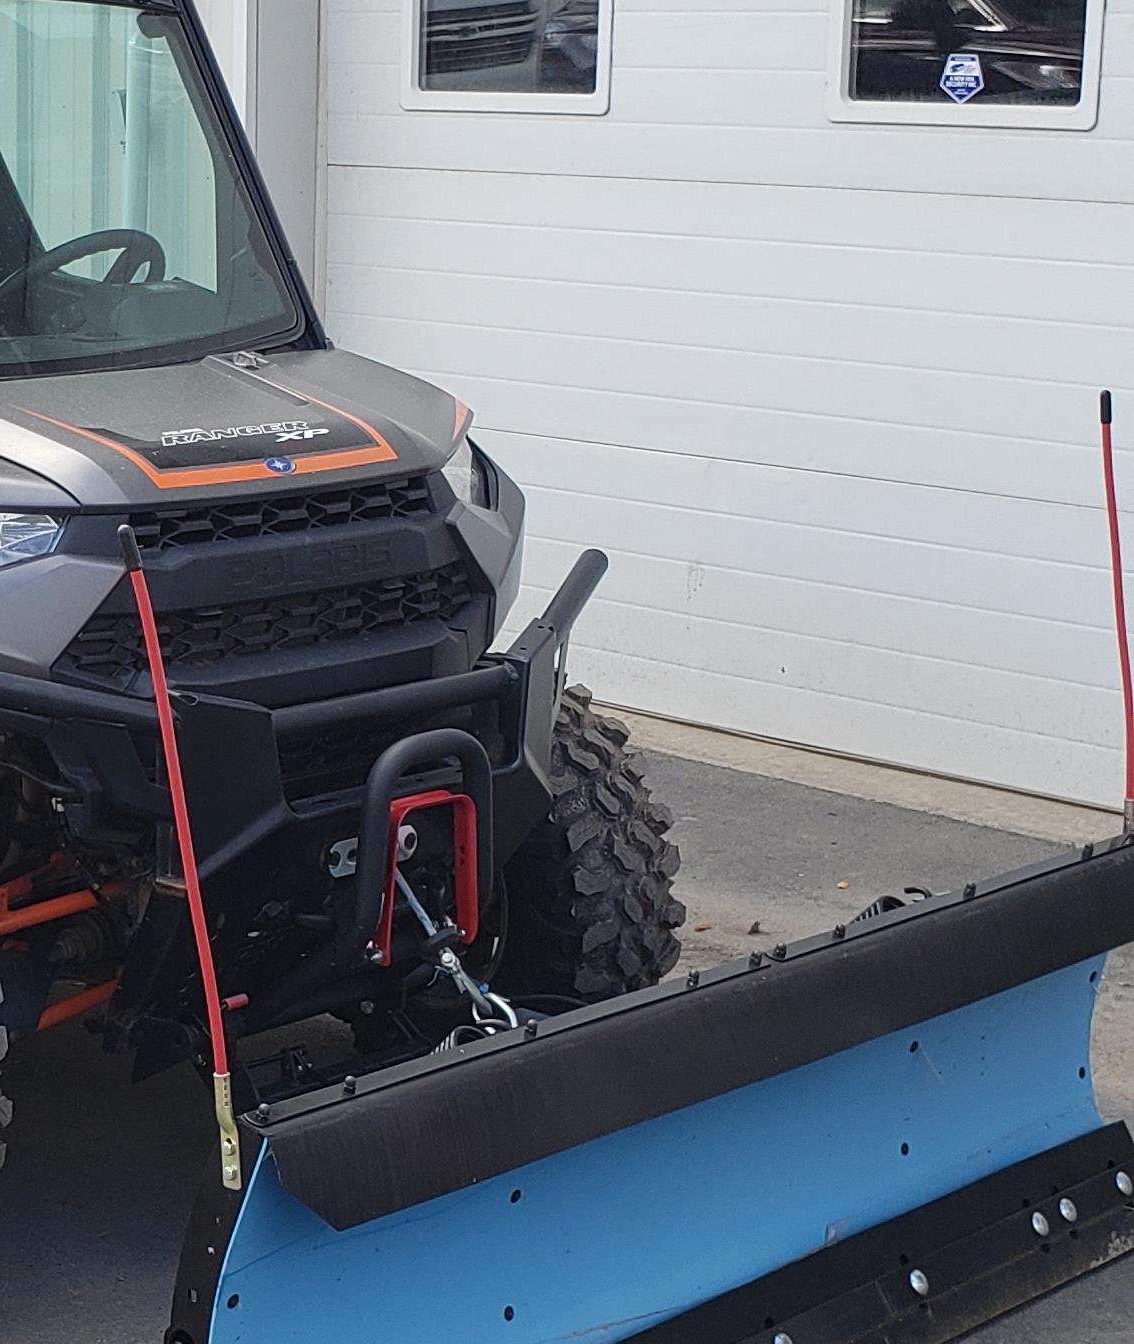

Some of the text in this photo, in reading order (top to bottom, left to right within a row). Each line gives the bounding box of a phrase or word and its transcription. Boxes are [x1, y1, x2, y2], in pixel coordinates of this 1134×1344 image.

[161, 420, 310, 447] RANGER
[275, 428, 330, 443] XP
[227, 539, 393, 594] POLARIS
